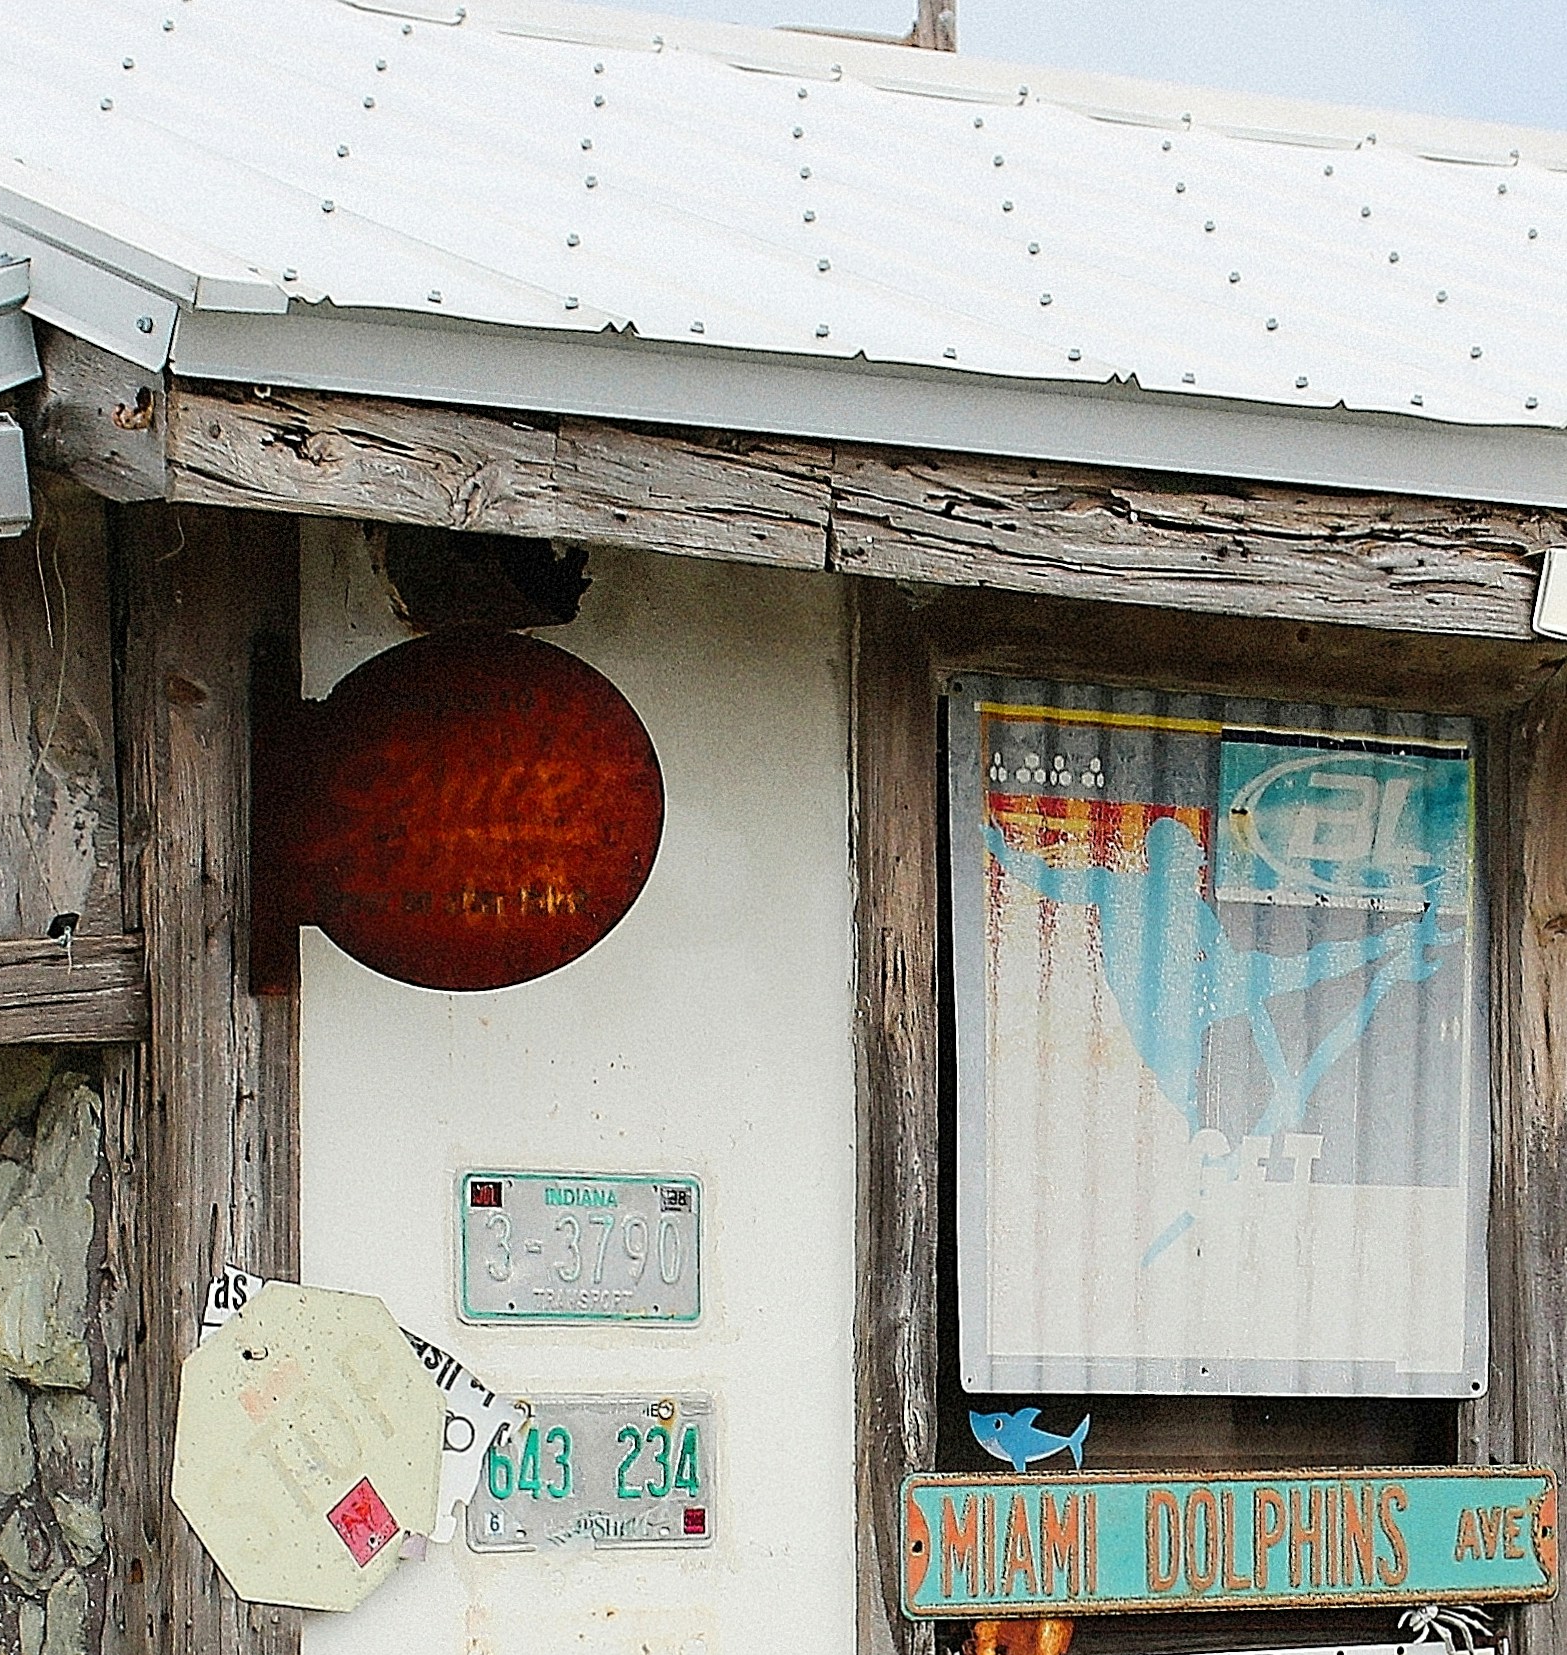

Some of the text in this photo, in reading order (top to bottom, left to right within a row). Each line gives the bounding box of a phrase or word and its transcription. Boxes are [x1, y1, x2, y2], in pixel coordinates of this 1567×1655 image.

[544, 1186, 620, 1208] INDIANA
[485, 1213, 681, 1285] 3-3790
[532, 1287, 634, 1311] TRANSPORT
[487, 1423, 700, 1500] 643 234
[939, 1484, 1528, 1597] MIAMI DOLPHINS AVE
